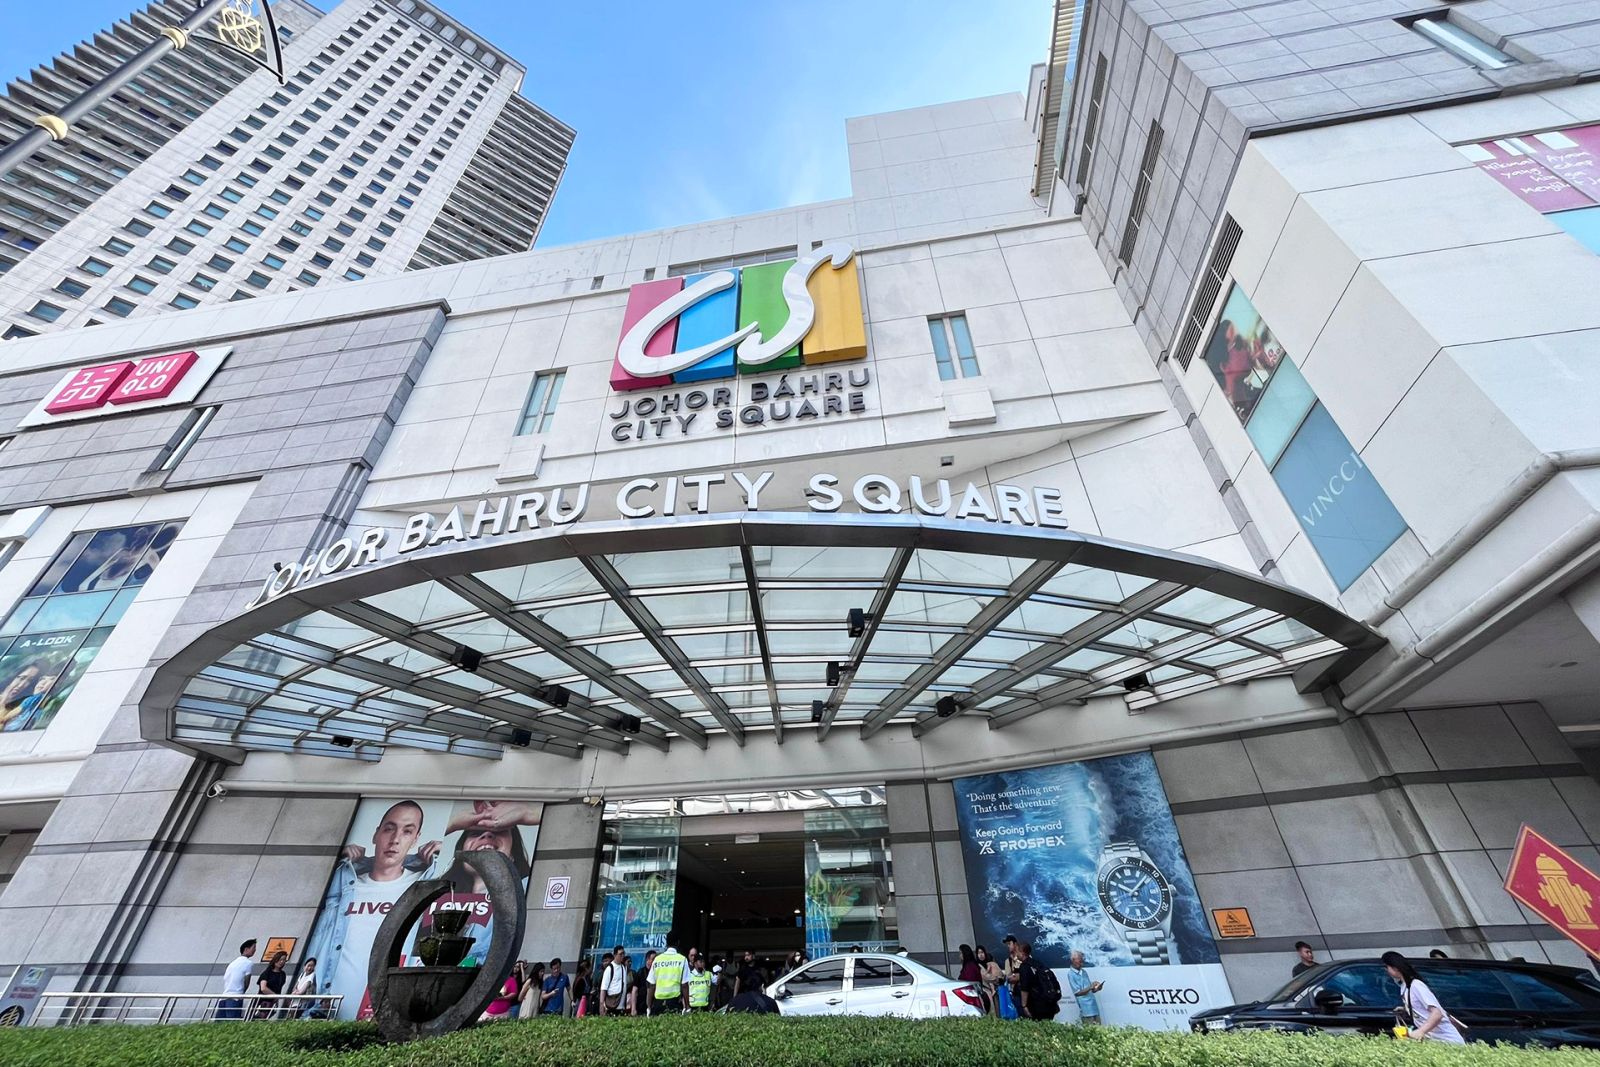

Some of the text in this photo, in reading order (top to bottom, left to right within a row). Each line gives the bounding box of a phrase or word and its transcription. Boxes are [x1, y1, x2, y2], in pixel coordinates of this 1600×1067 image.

[135, 358, 179, 376] UNI
[121, 374, 168, 395] QLO
[610, 387, 731, 419] JOHOR
[610, 392, 866, 441] CITY SQUARE
[1302, 452, 1363, 526] VINCCI
[245, 471, 1069, 610] JOHOR BAHRU CITY SQUARE
[20, 635, 76, 648] A-LOOK
[998, 786, 1041, 799] something
[999, 801, 1013, 811] the
[975, 820, 1063, 839] Keep Going Forward
[999, 835, 1066, 851] PROSPEX
[654, 960, 682, 968] SECURITY
[1128, 988, 1200, 1005] SEIKO
